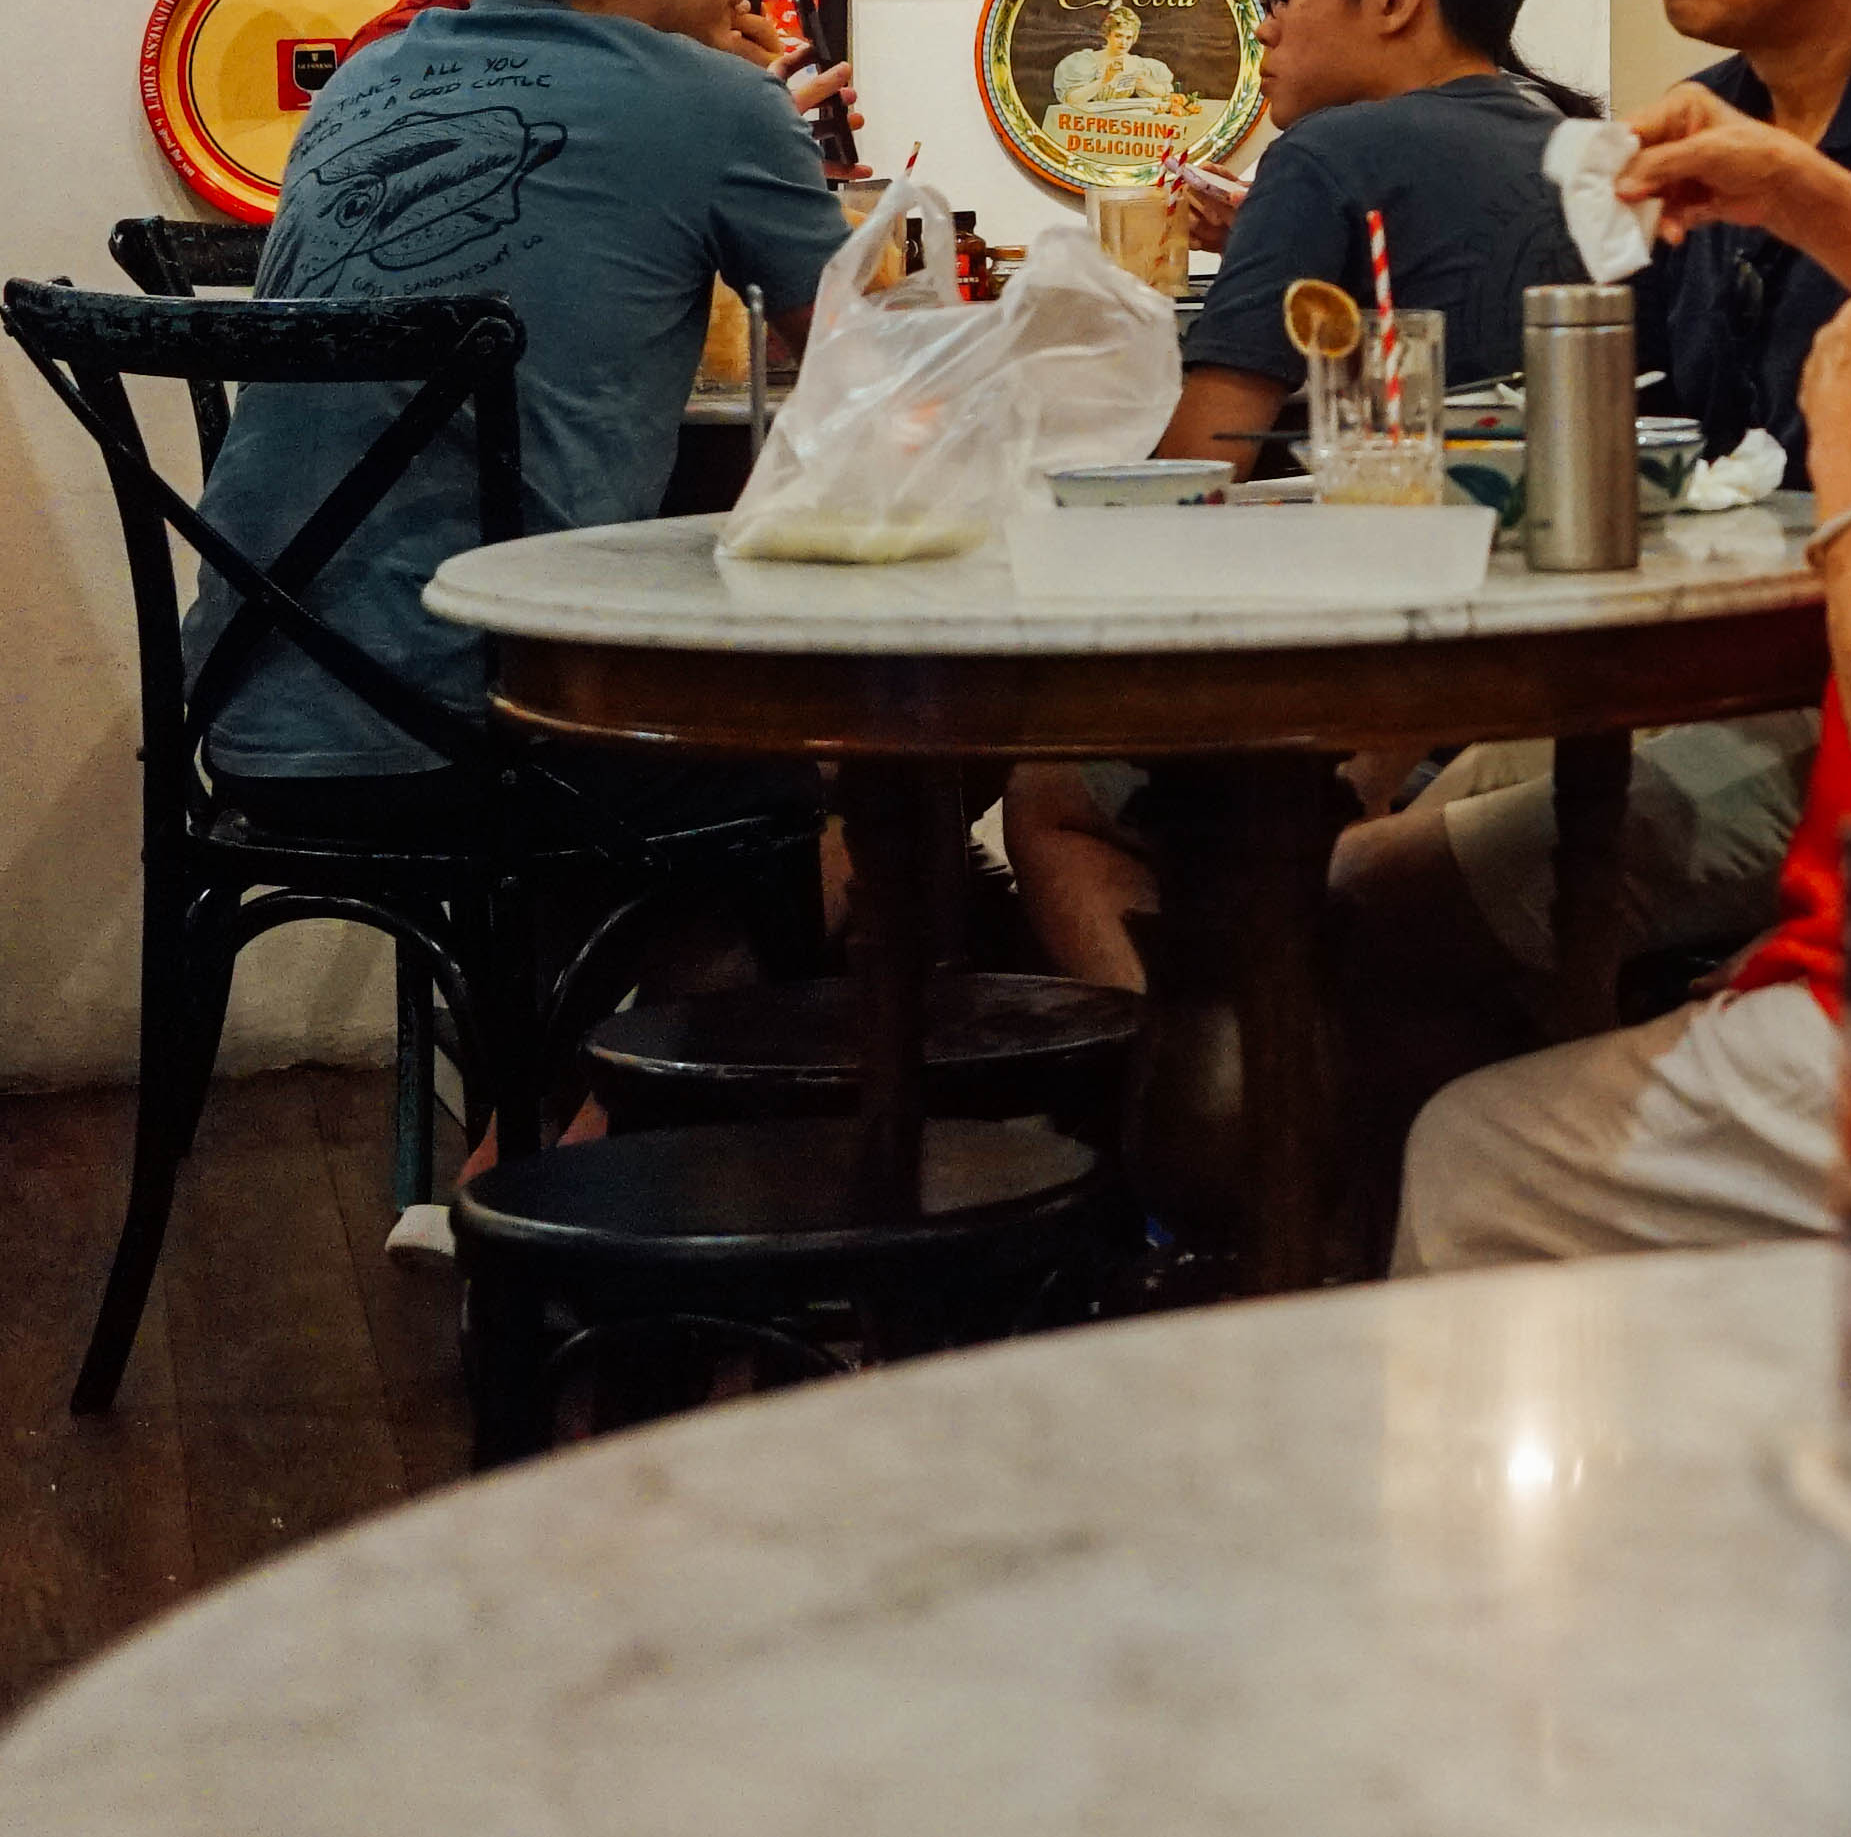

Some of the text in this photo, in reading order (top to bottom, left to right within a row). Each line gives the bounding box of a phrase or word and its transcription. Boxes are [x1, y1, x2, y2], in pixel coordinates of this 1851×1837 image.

[423, 63, 463, 82] ALL
[485, 56, 529, 74] YOU
[143, 64, 161, 112] STOUT
[383, 95, 398, 110] A
[408, 82, 462, 101] GOOD
[472, 74, 553, 90] CUTTLE
[1058, 113, 1189, 142] REFRESHING!
